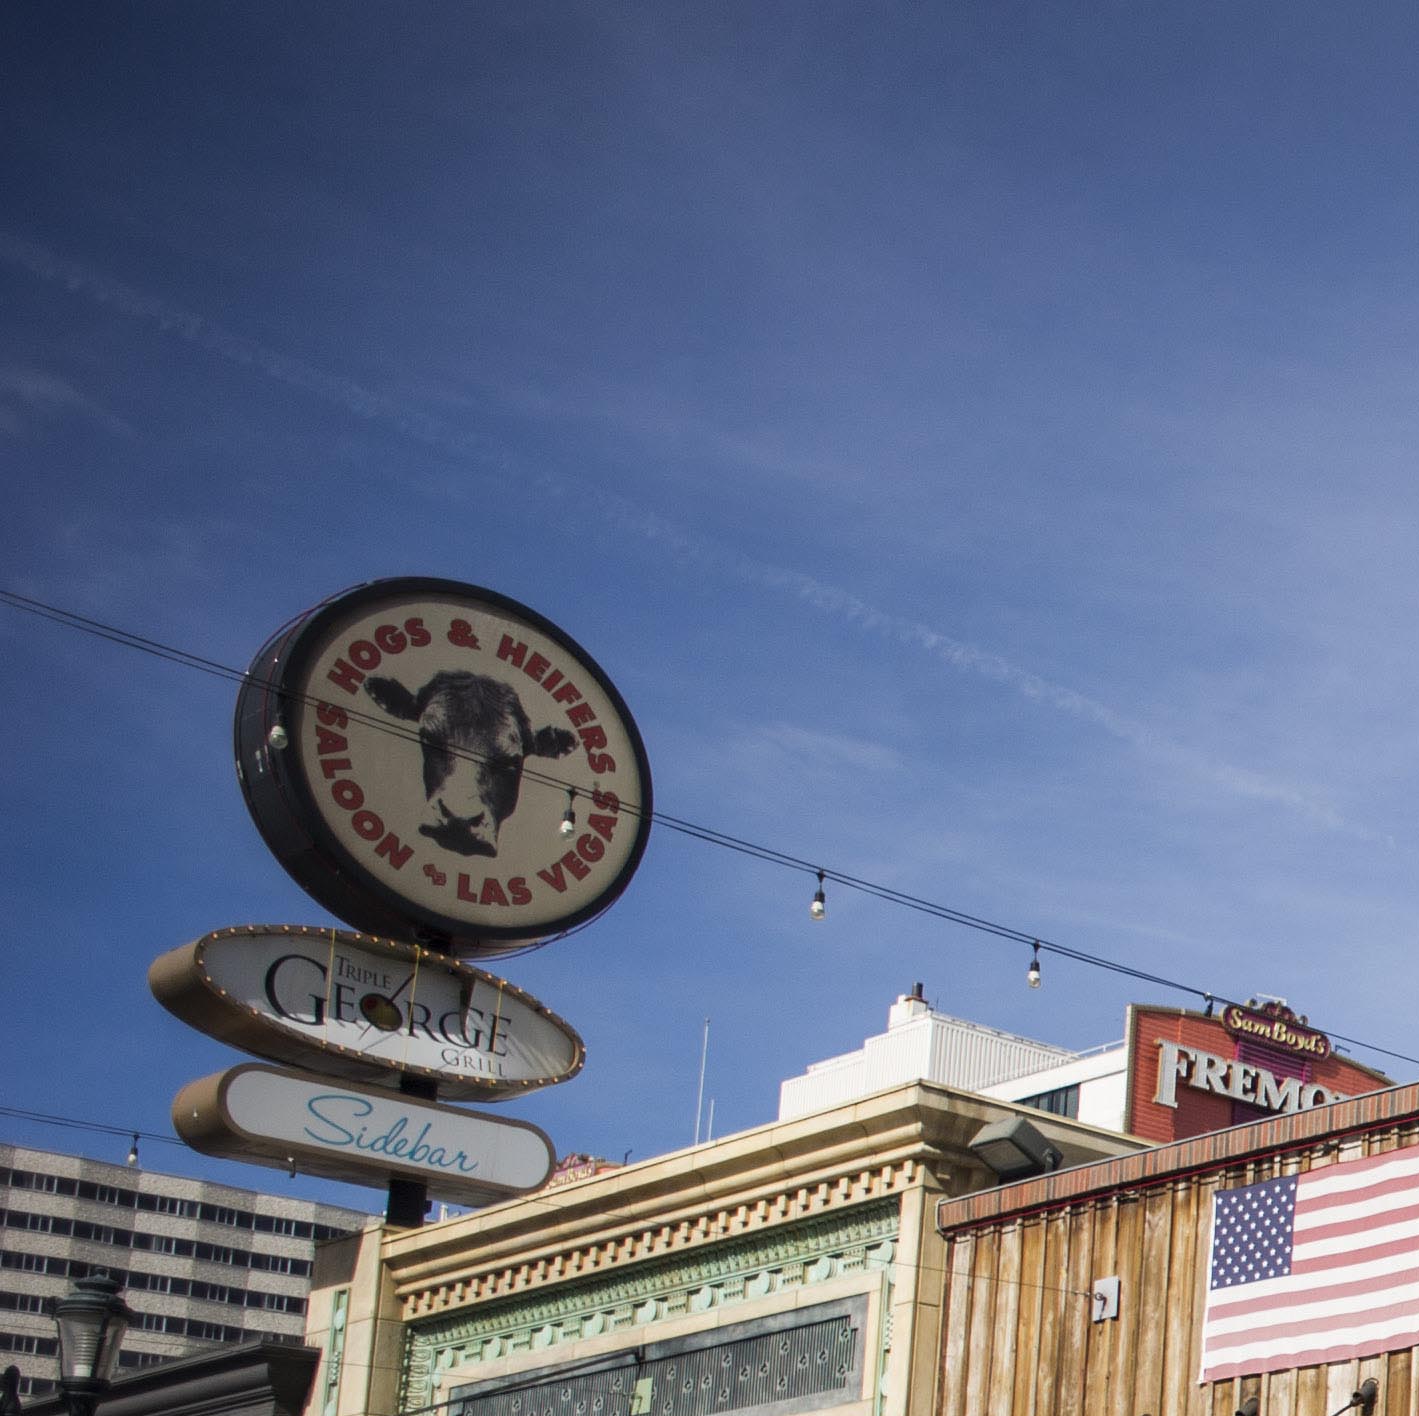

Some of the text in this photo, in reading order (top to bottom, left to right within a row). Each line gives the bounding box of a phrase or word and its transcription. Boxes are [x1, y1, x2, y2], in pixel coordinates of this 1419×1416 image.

[327, 617, 617, 775] HOGS & HEIFERS
[314, 700, 621, 906] SALOON LAS VEGAS
[334, 954, 393, 990] TRIPLE
[440, 1049, 508, 1078] GRILL
[1229, 1008, 1327, 1056] Sam Boyd's
[1154, 1038, 1352, 1115] FREMO
[303, 1094, 480, 1174] Sidebar
